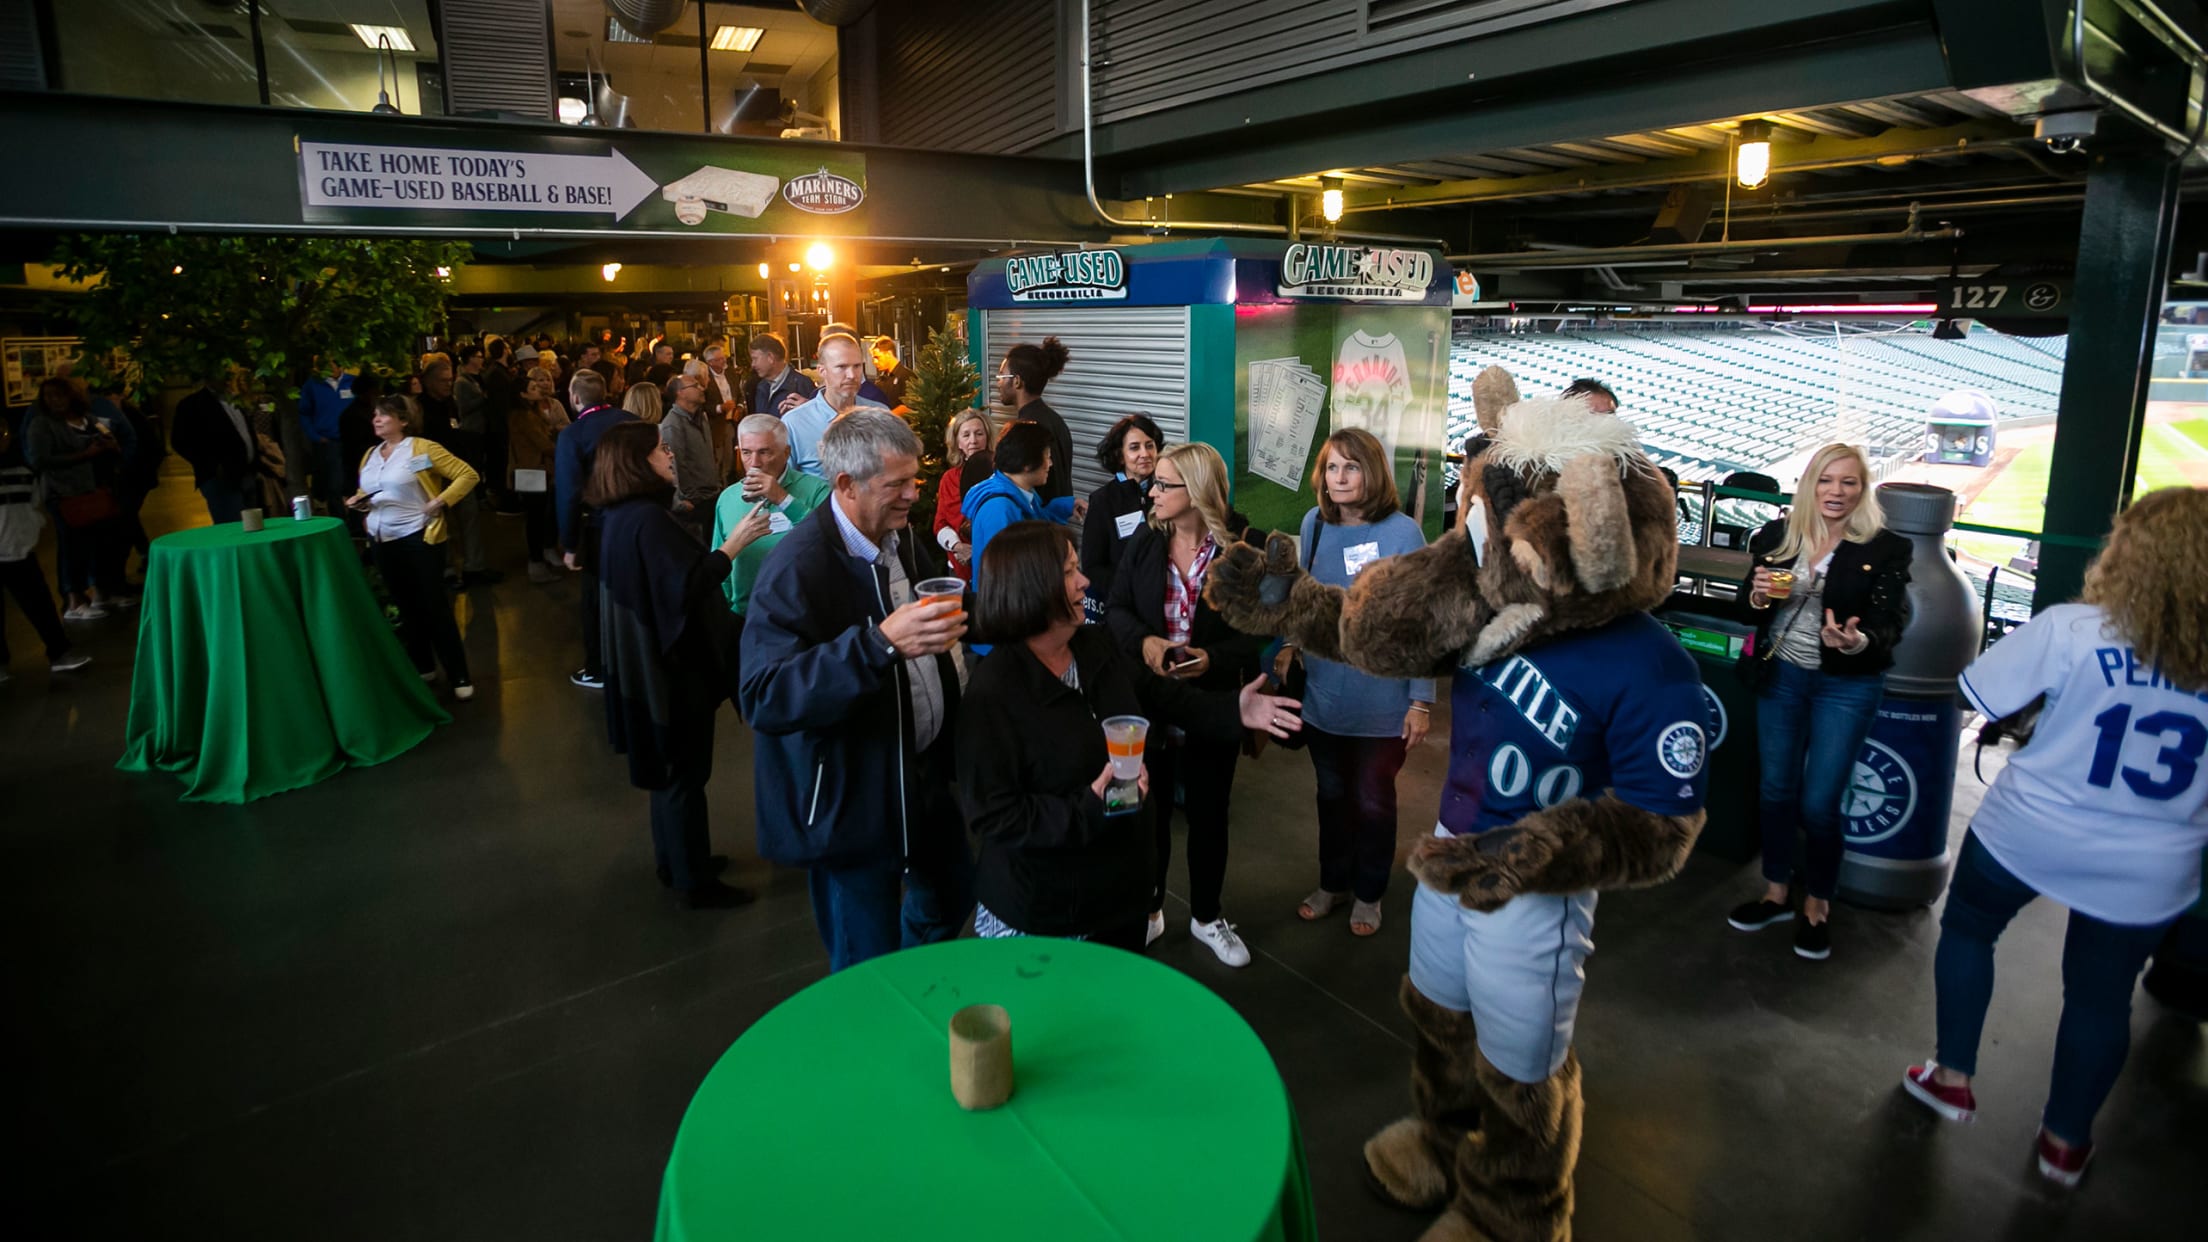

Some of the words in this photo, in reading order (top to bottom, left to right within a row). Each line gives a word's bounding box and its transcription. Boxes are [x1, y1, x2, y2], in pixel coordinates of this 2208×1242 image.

[317, 151, 373, 173] TAKE
[380, 154, 442, 175] HOME
[447, 157, 526, 178] TODAY'S
[321, 177, 445, 201] GAME-USED
[452, 182, 542, 203] BASEBALL
[547, 185, 559, 203] &
[565, 186, 613, 206] BASE!
[790, 178, 859, 200] MARINERS
[801, 194, 821, 204] TEAM
[824, 194, 847, 205] STORE
[1006, 254, 1058, 293] GAME
[1061, 250, 1124, 288] USED
[1284, 244, 1361, 287] GAME
[1368, 248, 1435, 289] USED
[1027, 289, 1104, 300] MEMORABILIA
[1306, 285, 1403, 297] MEMORABILIA
[1951, 285, 2008, 309] 127
[2088, 703, 2208, 801] 13
